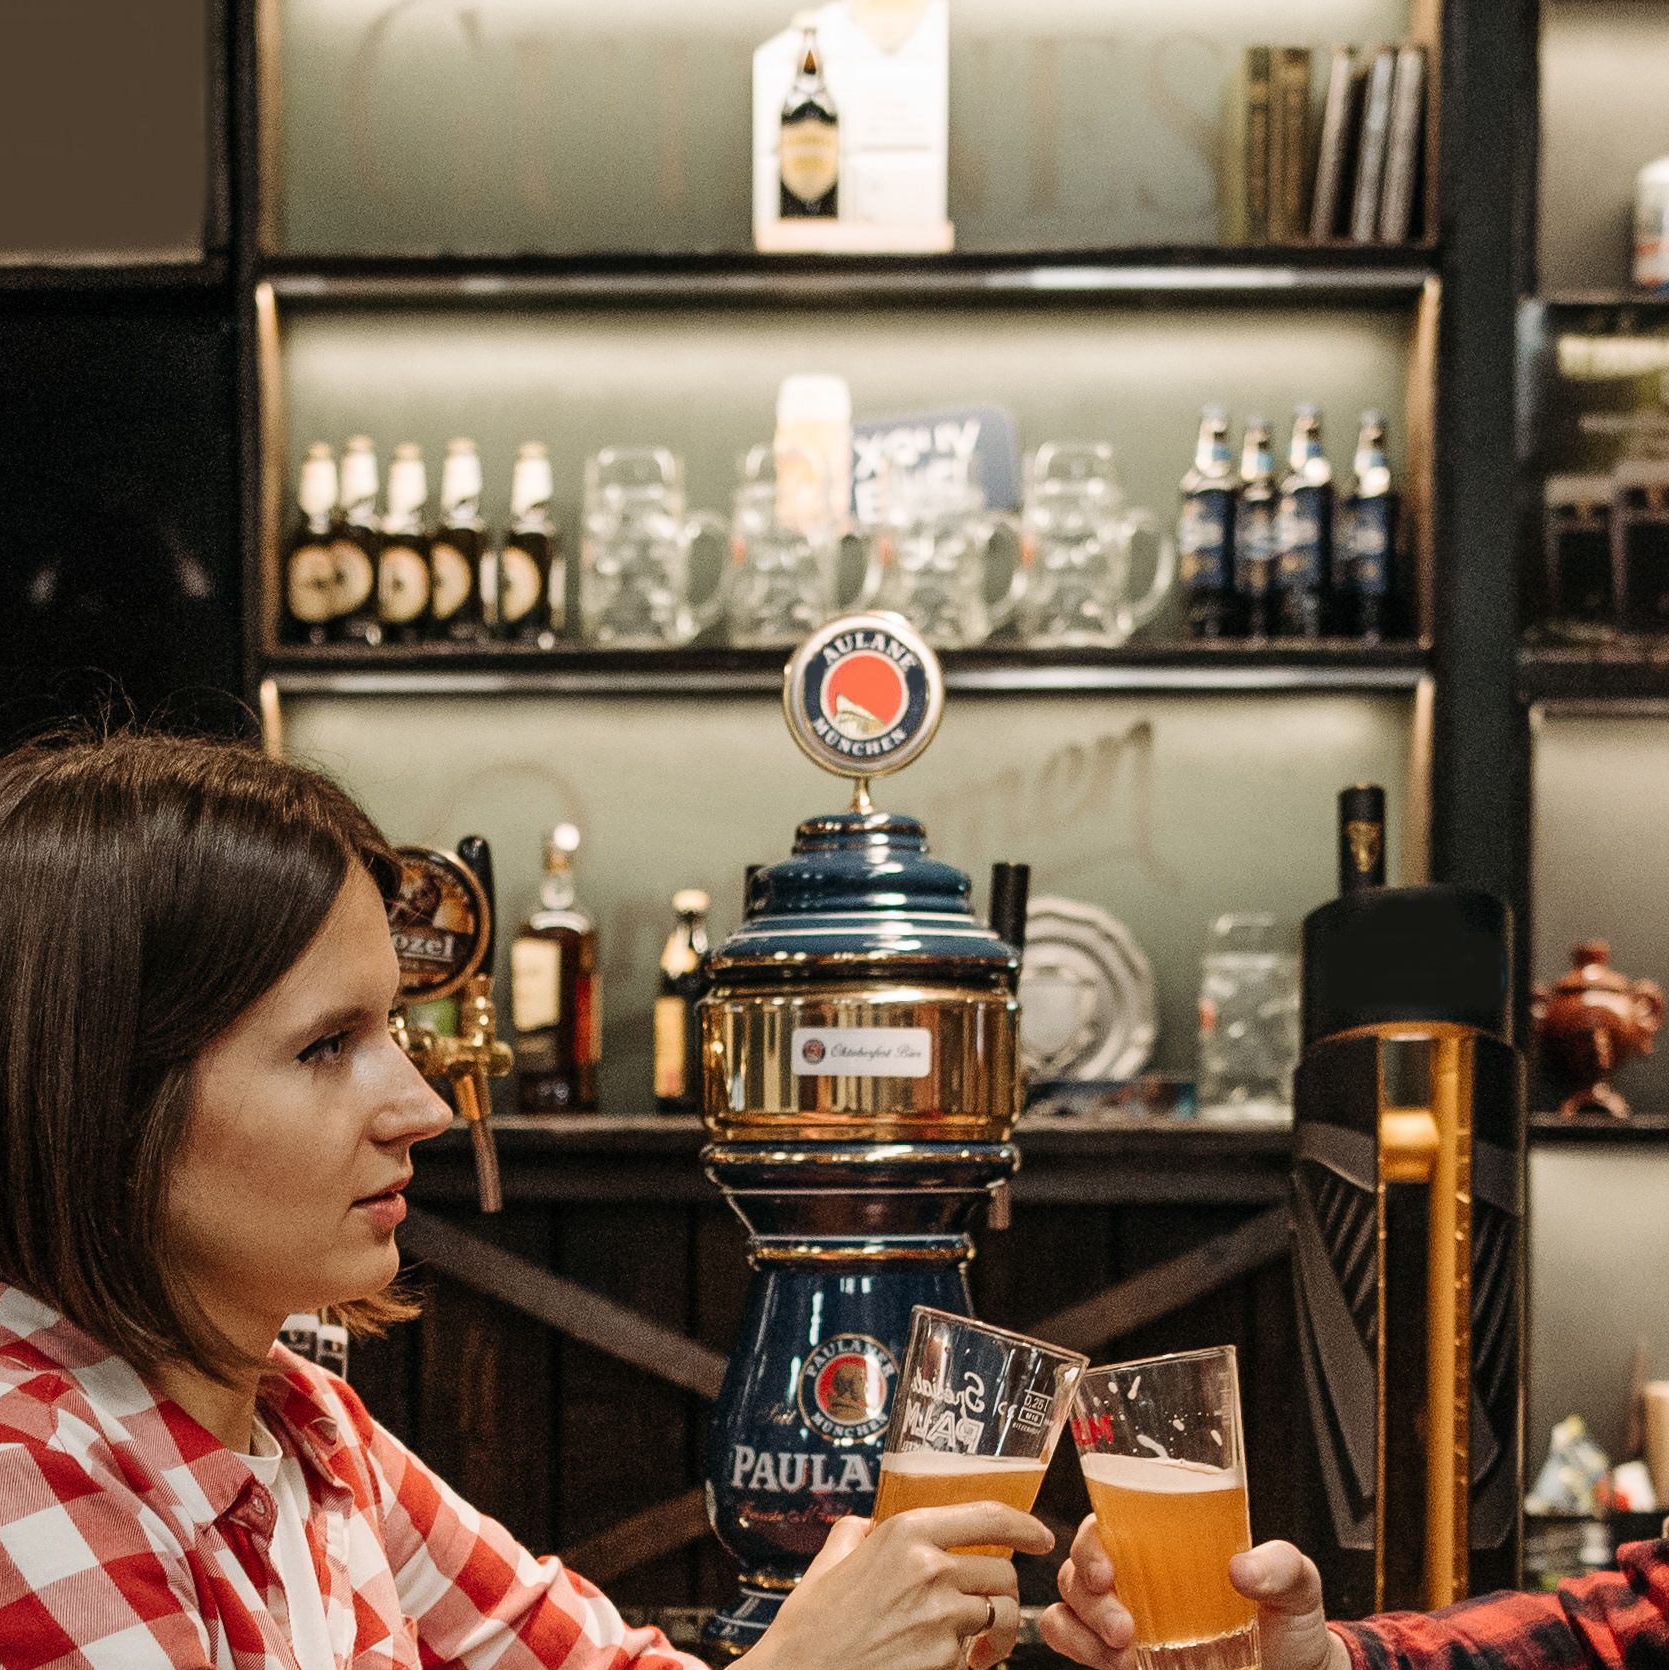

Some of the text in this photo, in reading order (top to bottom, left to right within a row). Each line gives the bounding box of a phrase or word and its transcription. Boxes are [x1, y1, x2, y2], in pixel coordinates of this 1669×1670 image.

[389, 932, 455, 959] ozel
[806, 1338, 896, 1379] PAULANER
[730, 1444, 884, 1493] PAULA
